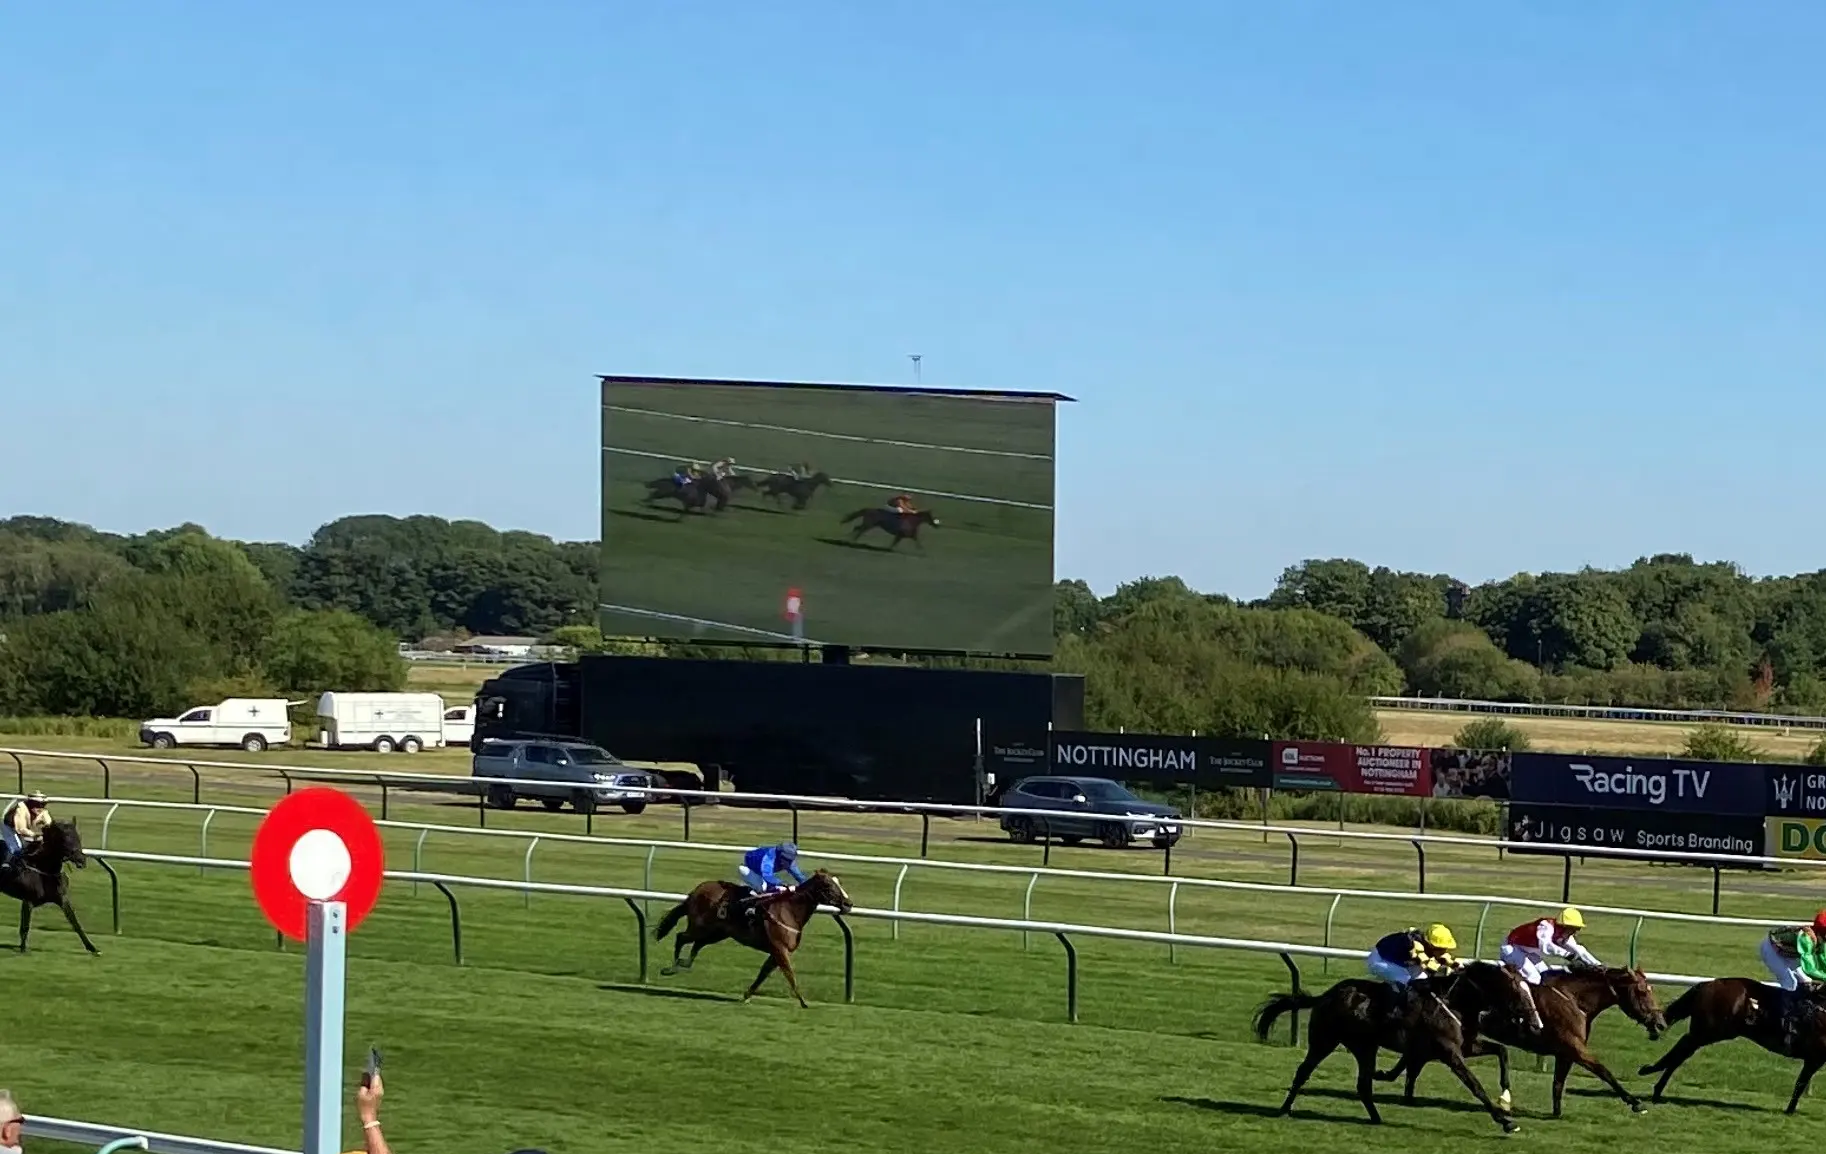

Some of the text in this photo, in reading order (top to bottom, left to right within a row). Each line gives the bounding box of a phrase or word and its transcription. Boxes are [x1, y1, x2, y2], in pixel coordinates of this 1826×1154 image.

[1057, 744, 1196, 770] NOTTINGHAM
[1378, 746, 1421, 759] PROPERTY
[1357, 756, 1410, 769] AUCTIONEER
[1360, 767, 1418, 780] NOTTINGHAM
[1569, 763, 1711, 804] Racing TV
[1637, 829, 1685, 848] Sports
[1688, 833, 1753, 854] Branding
